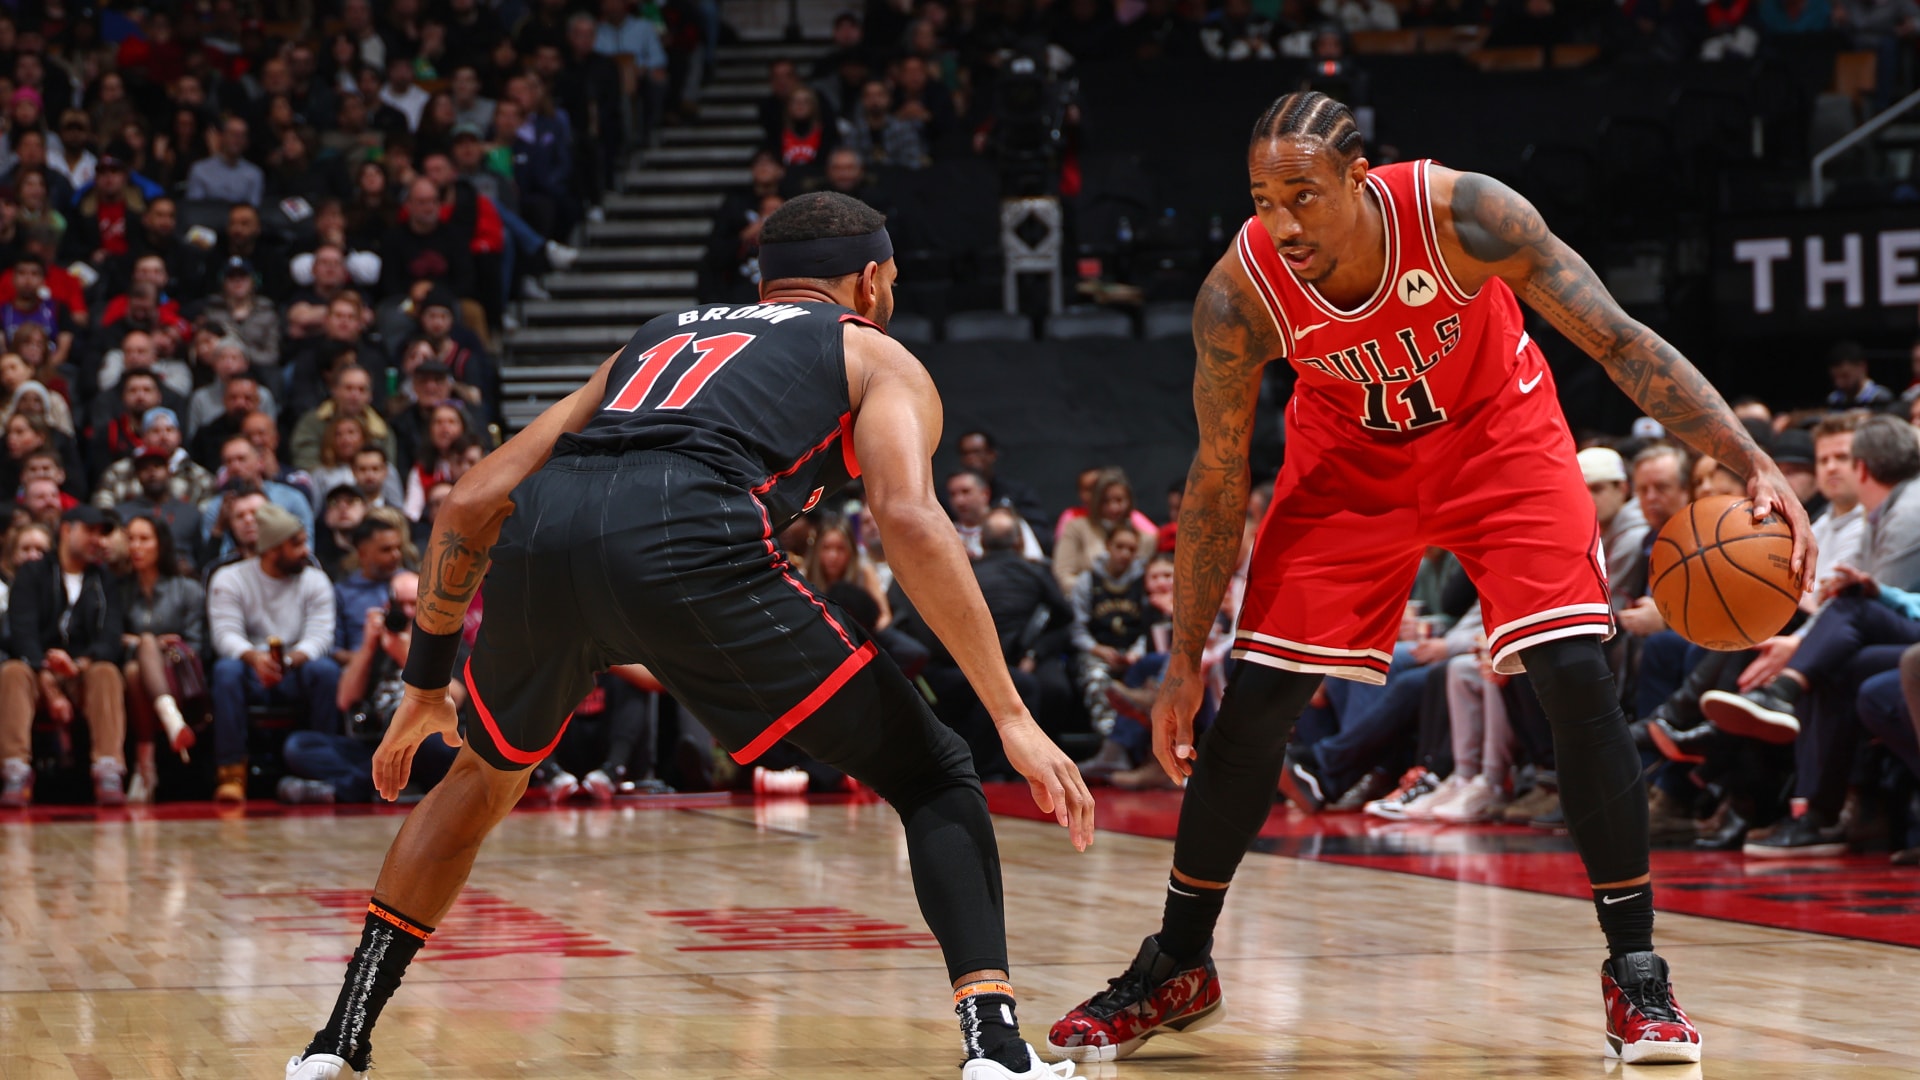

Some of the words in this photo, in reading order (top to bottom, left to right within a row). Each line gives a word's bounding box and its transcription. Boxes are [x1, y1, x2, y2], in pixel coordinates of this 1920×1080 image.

[1734, 229, 1920, 314] THE
[678, 302, 811, 327] BROWN
[604, 332, 756, 412] 11
[1360, 375, 1448, 432] 11
